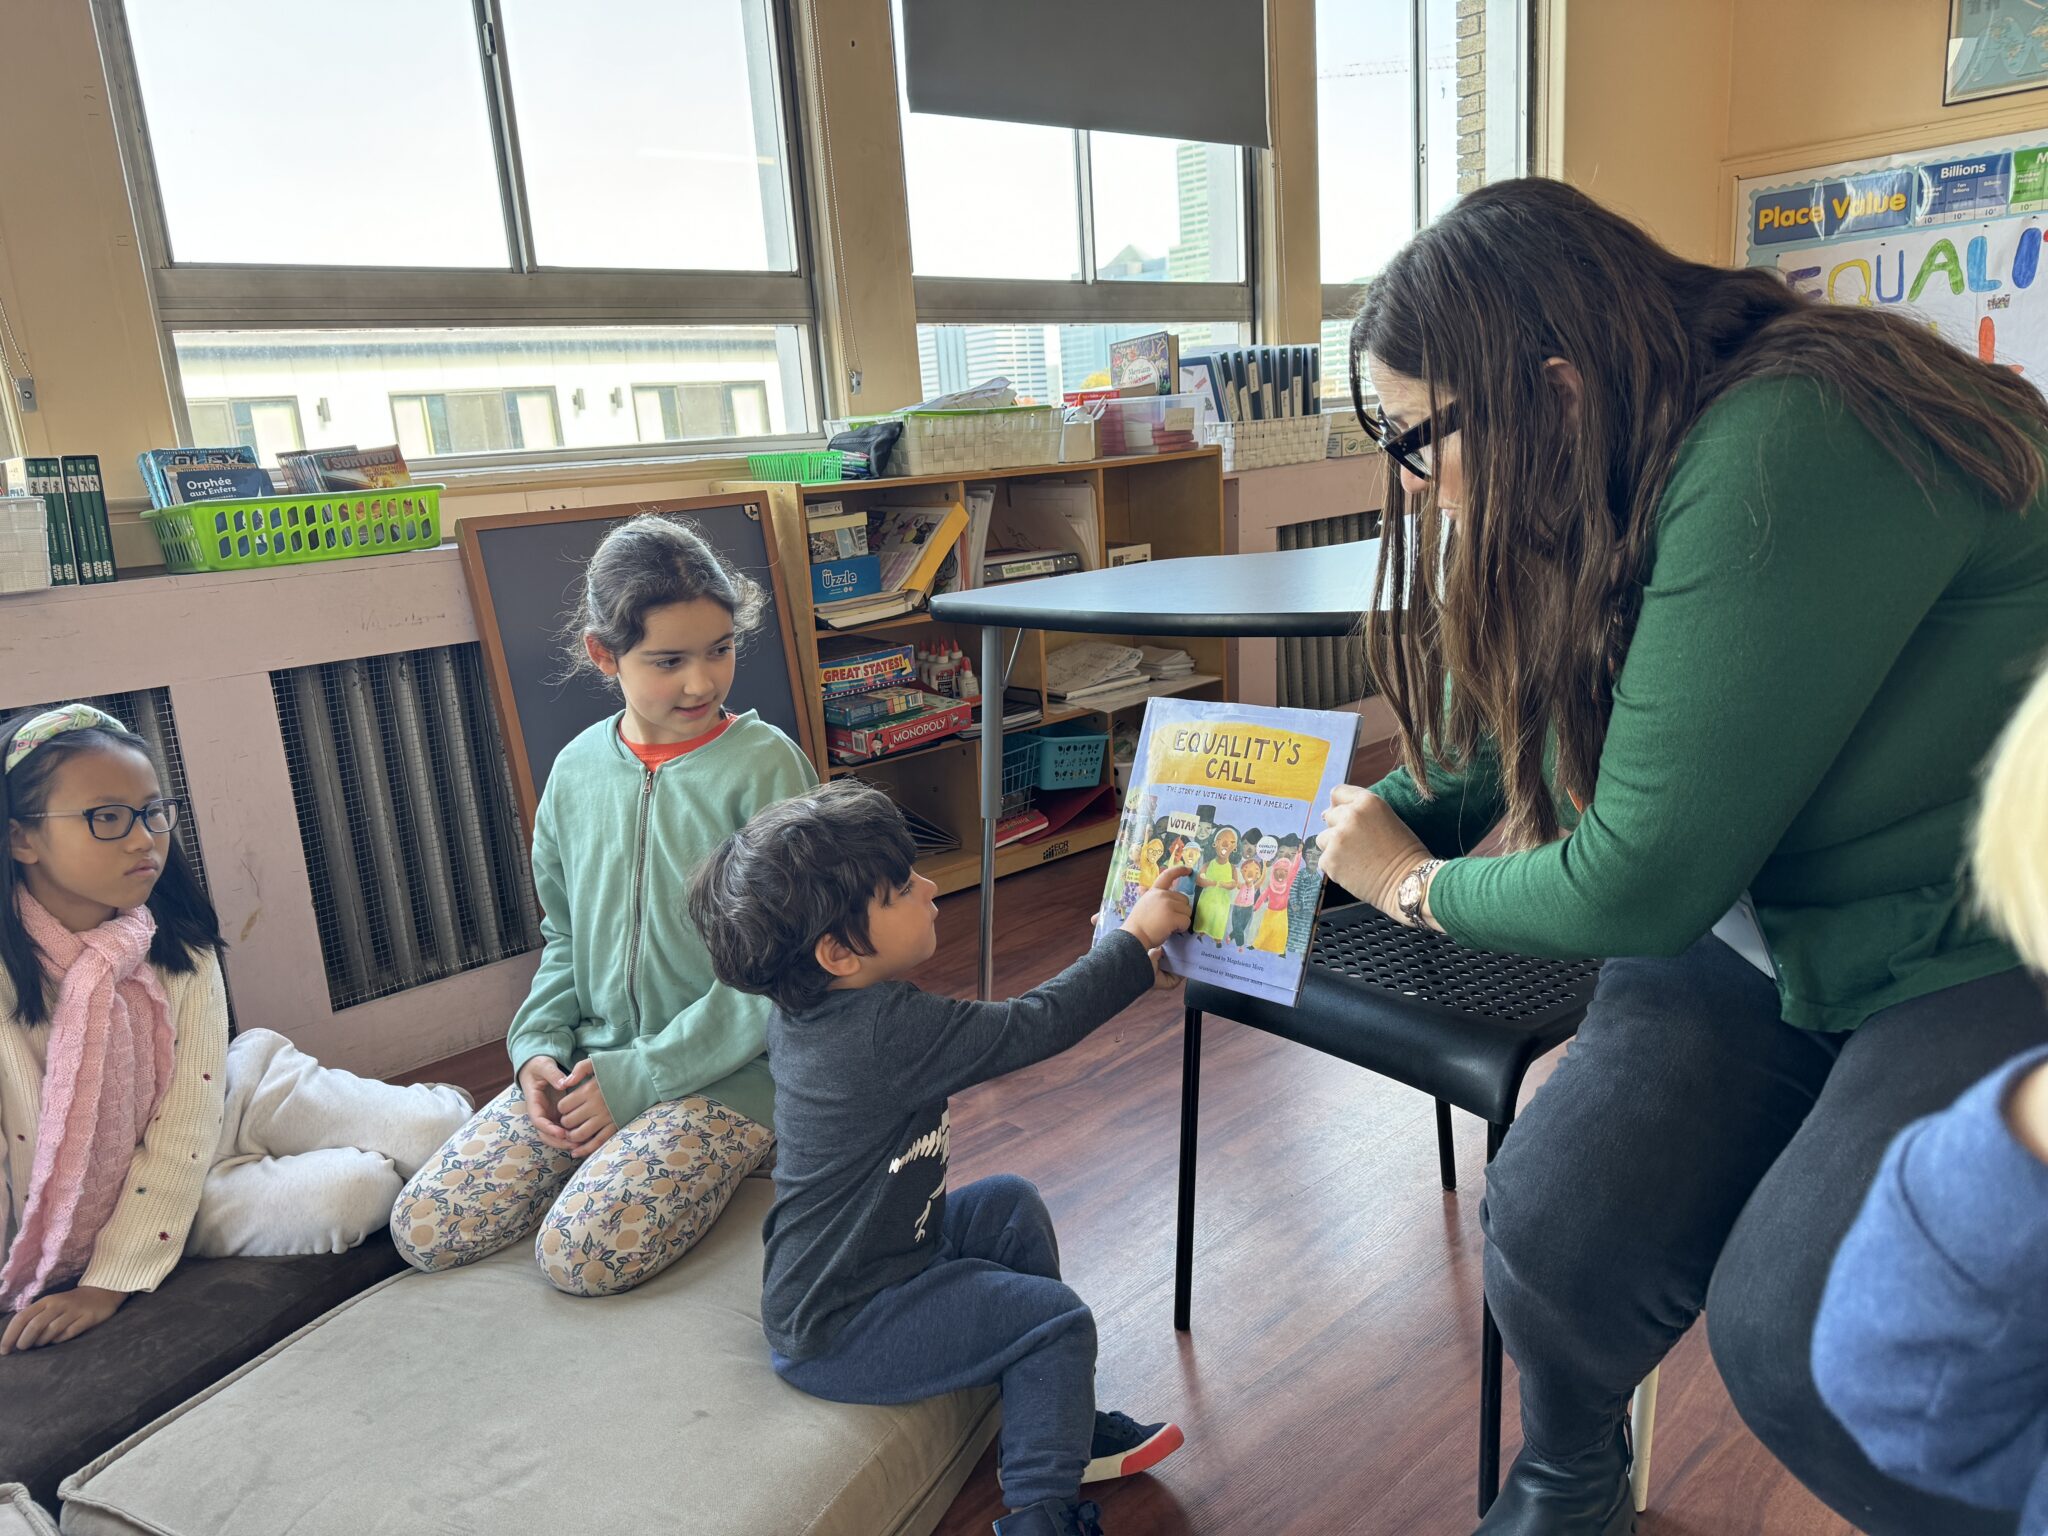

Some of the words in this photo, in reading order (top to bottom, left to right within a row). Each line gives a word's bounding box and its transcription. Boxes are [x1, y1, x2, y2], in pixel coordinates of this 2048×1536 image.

[1940, 163, 1986, 179] Billions
[1758, 205, 1825, 231] Place
[1832, 192, 1907, 220] Value
[1786, 227, 2048, 307] EQUALI
[331, 450, 397, 470] SURVIVED
[186, 477, 232, 491] Orphée
[190, 490, 207, 498] aux
[208, 485, 237, 496] Enfers
[823, 667, 861, 682] GREAT
[863, 655, 904, 677] STATES!
[893, 718, 946, 743] MONOPOLY
[1173, 728, 1302, 765] EQUALITY'S
[1205, 757, 1256, 785] CALL
[1178, 787, 1195, 796] STORY
[1203, 789, 1228, 800] VOTING
[1228, 793, 1251, 804] RIGHTS
[1254, 798, 1262, 806] IN
[1263, 800, 1293, 811] AMERICA
[1170, 816, 1197, 832] VOTAR
